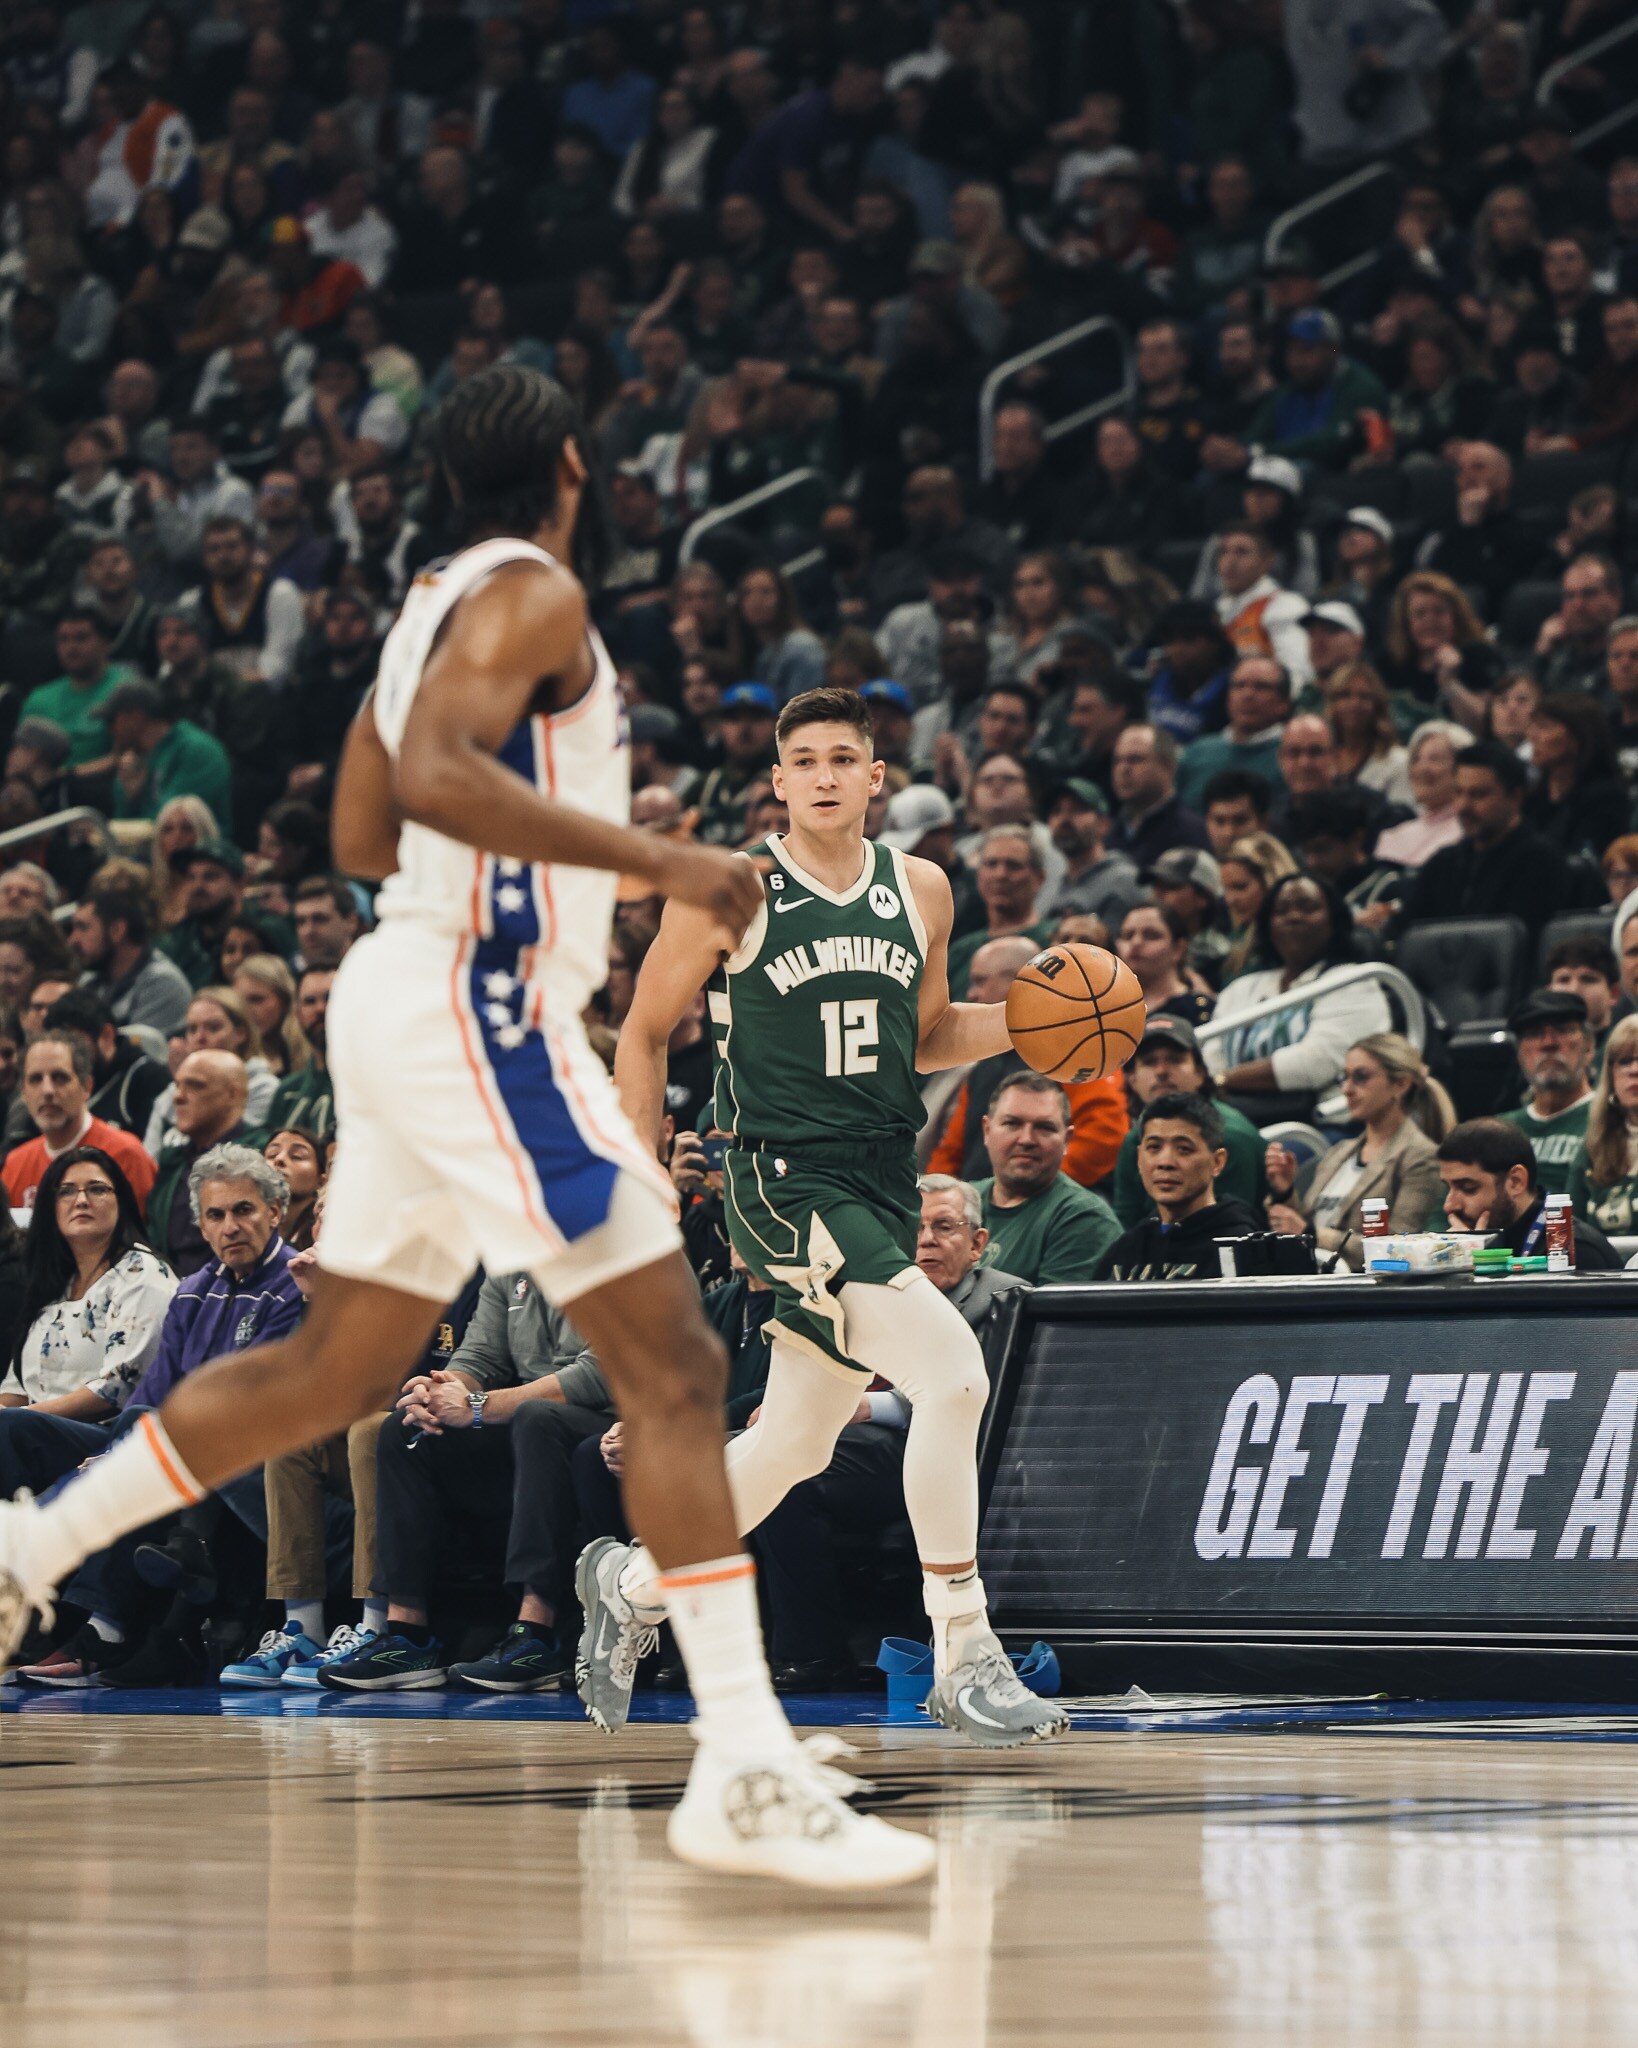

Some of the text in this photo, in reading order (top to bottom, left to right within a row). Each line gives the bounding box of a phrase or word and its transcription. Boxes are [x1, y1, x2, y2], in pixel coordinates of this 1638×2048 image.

[769, 873, 785, 891] 6
[763, 936, 918, 996] MILWAUKEE
[820, 998, 879, 1077] 12
[1193, 1369, 1638, 1561] GET THE A
